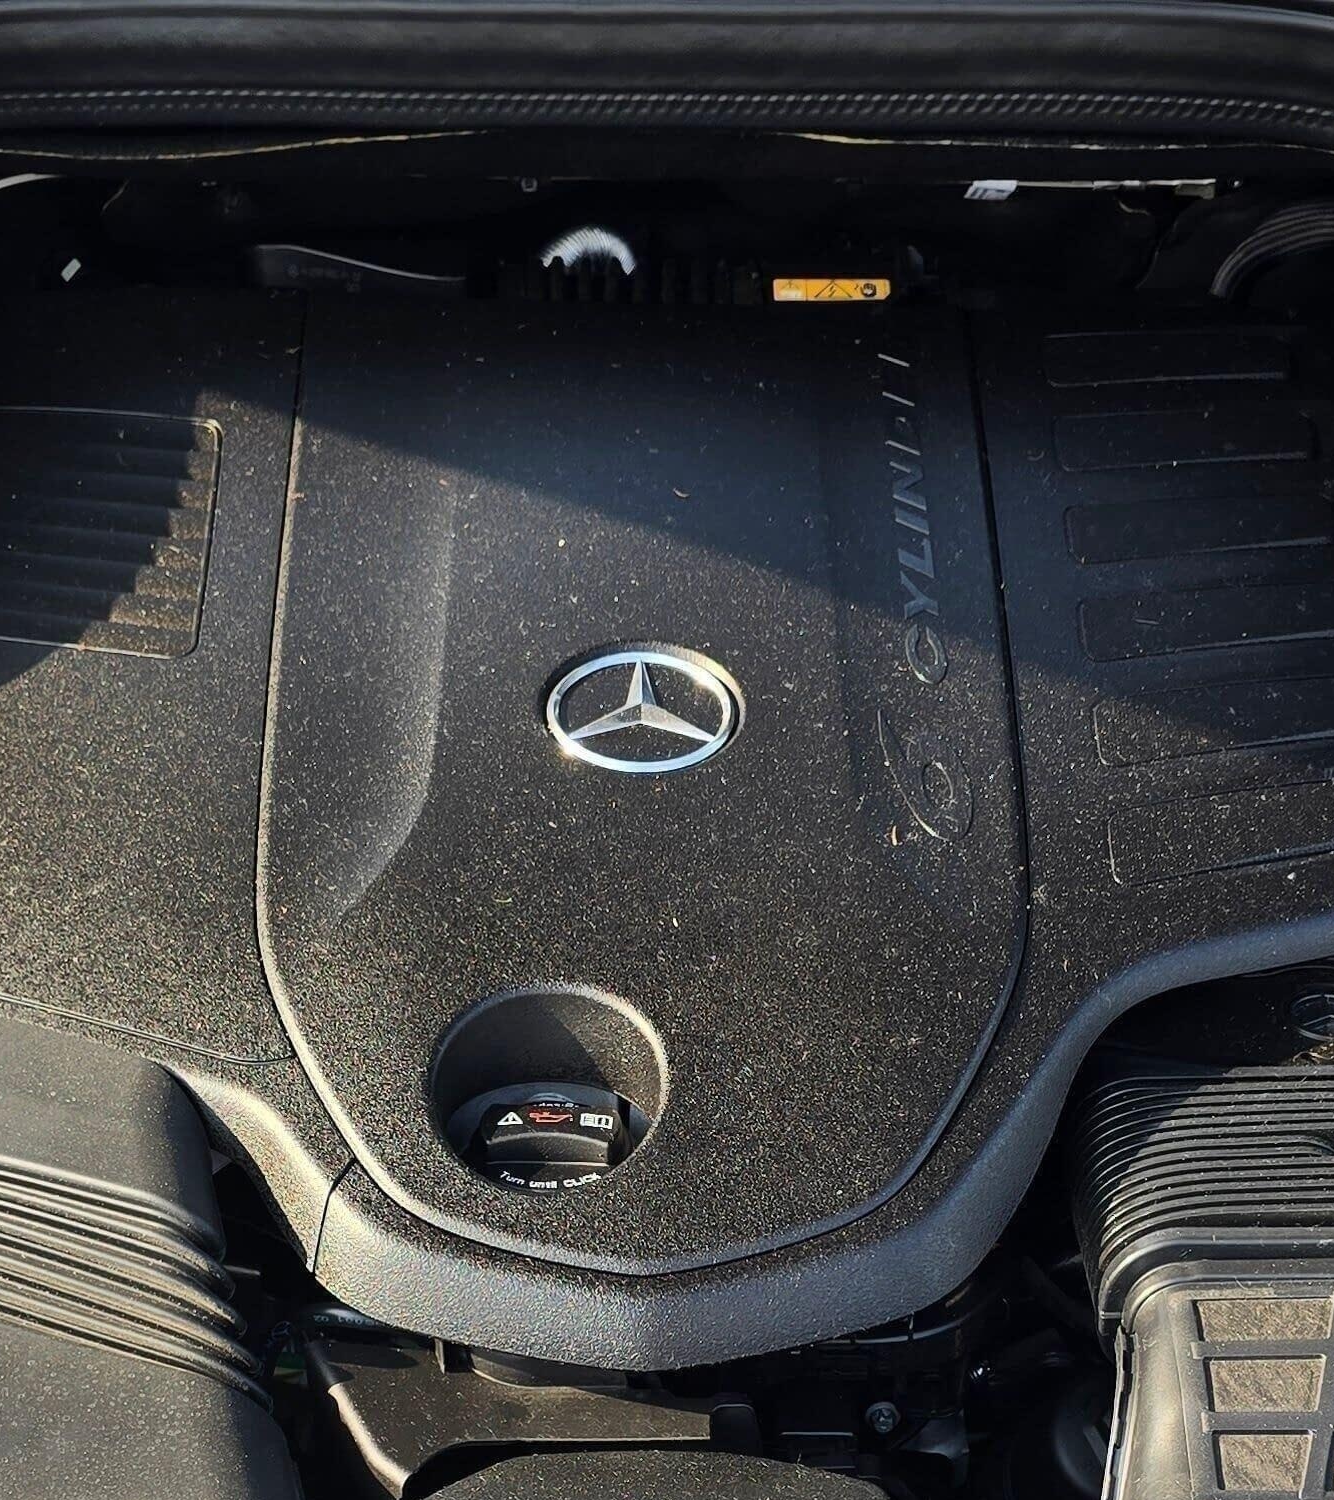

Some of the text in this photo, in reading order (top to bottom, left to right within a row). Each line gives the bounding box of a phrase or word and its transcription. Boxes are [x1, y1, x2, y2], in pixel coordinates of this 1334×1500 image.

[500, 1170, 602, 1189] Turn until CLICK
